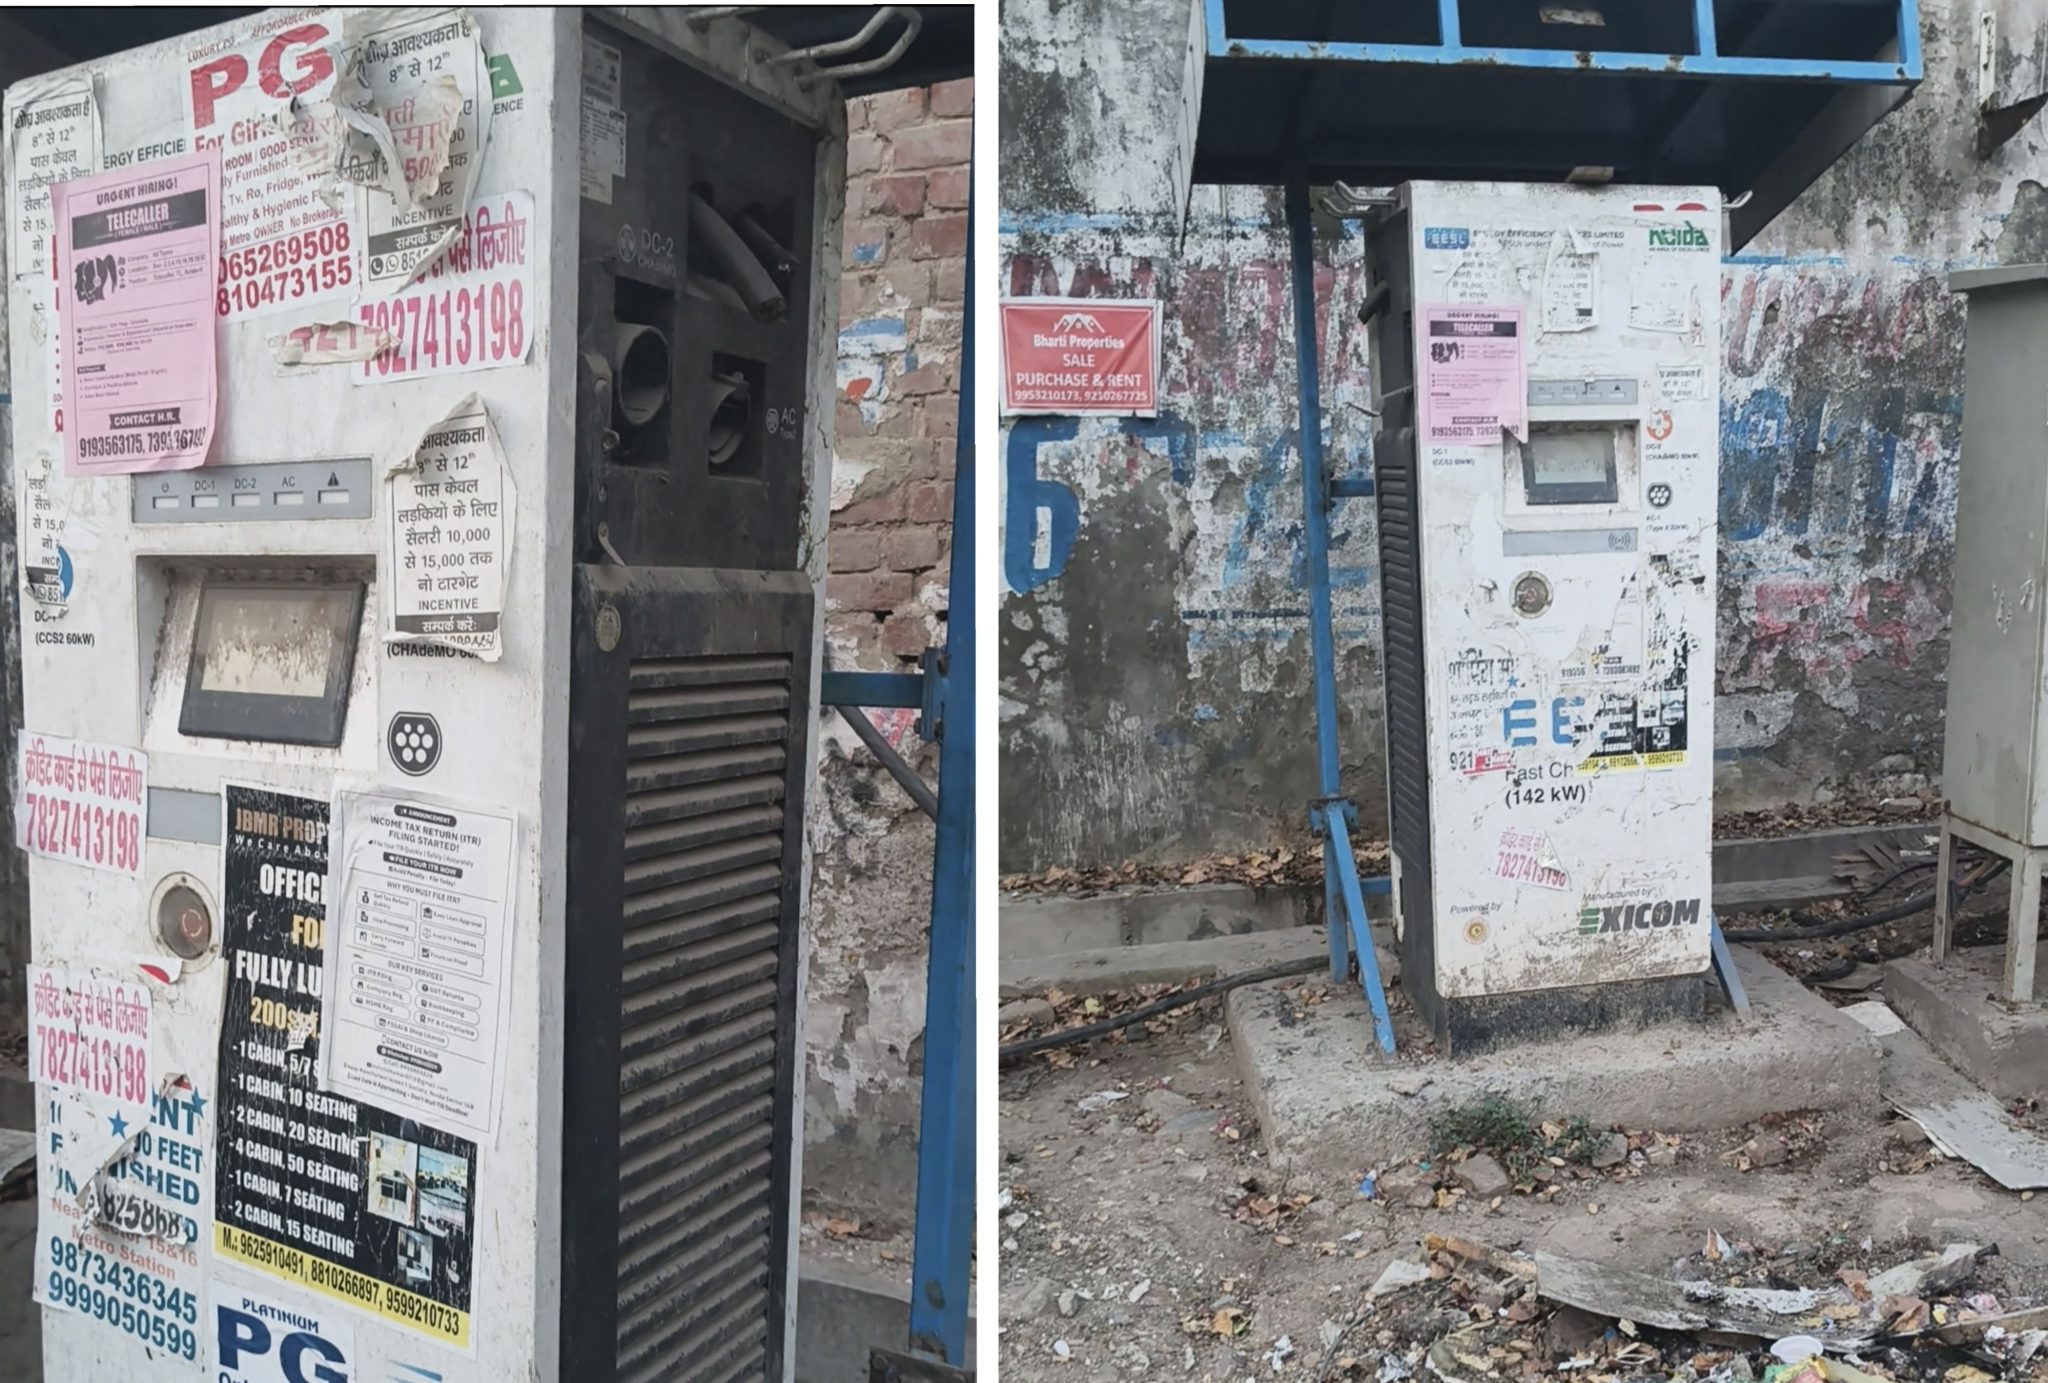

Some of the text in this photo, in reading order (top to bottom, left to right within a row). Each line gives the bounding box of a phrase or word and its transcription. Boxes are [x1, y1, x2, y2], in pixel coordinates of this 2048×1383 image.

[392, 22, 460, 58] आवश्यकता
[190, 24, 335, 130] PG
[35, 102, 83, 125] आवश्यकता
[30, 154, 49, 169] पास
[103, 138, 184, 169] ERGY EFFICIE
[259, 140, 287, 160] GOOD
[235, 155, 288, 183] Furnished
[97, 186, 135, 206] URGENT
[106, 203, 170, 232] TELECALLER
[252, 207, 260, 220] &
[392, 204, 453, 228] INCENTIVE
[253, 220, 284, 239] OWNER
[290, 213, 301, 228] No
[641, 228, 674, 258] DC-2
[1033, 334, 1126, 350] Bharti Properties
[1062, 353, 1096, 367] SALE
[1016, 372, 1143, 387] PURCHASE & RENT
[1015, 390, 1148, 403] 9953210173, 9210267725
[114, 411, 177, 427] CONTACT H.R.
[781, 408, 797, 424] AC
[436, 453, 448, 473] से
[194, 475, 296, 491] DC-1 DC-2 AC
[414, 474, 479, 497] पास केवल
[397, 499, 499, 527] लड़कियों के लिए
[404, 525, 491, 547] सैलरी 10,000
[404, 551, 493, 570] से 15,000 तक
[418, 570, 480, 592] नो टारगेट
[418, 598, 480, 612] INCENTIVE
[35, 631, 96, 648] (CCS2 60kW)
[1505, 784, 1587, 809] (142 kW)
[26, 793, 140, 872] 7827413198
[370, 815, 482, 848] INCOME TAX RETURN (ITR)
[388, 830, 416, 844] FILING
[417, 836, 460, 853] STARTED!
[235, 834, 289, 854] We Care
[410, 859, 428, 869] YOUR
[440, 865, 458, 876] NOW
[387, 881, 446, 902] WHY YOU MUST FILE
[1583, 888, 1652, 901] Manufactured by
[1450, 901, 1502, 915] Powered by
[1578, 898, 1701, 936] EXICOM
[236, 949, 293, 992] FULLY
[387, 960, 444, 982] OUR KEY SERVICES
[248, 1040, 287, 1072] CABIN,
[386, 1037, 440, 1060] CONTACT US NOW
[37, 1025, 146, 1105] 7827413198
[246, 1074, 358, 1124] CABIN, 10 SEATING
[246, 1108, 360, 1159] CABIN, 20 SEATING
[159, 1134, 203, 1174] FEET
[245, 1138, 360, 1193] CABIN, 50 SEATING
[243, 1171, 345, 1222] CABIN, 7 SEATING
[244, 1204, 355, 1259] CABIN, 15 SEATING
[72, 1225, 176, 1281] Metro Station
[51, 1236, 198, 1325] 9873436345
[240, 1233, 308, 1283] 9625910491,
[311, 1260, 383, 1312] 8810266897,
[386, 1288, 460, 1337] 9599210733
[49, 1271, 197, 1362] 9999050599
[242, 1297, 320, 1334] PLATINIUM
[217, 1304, 349, 1383] PG
